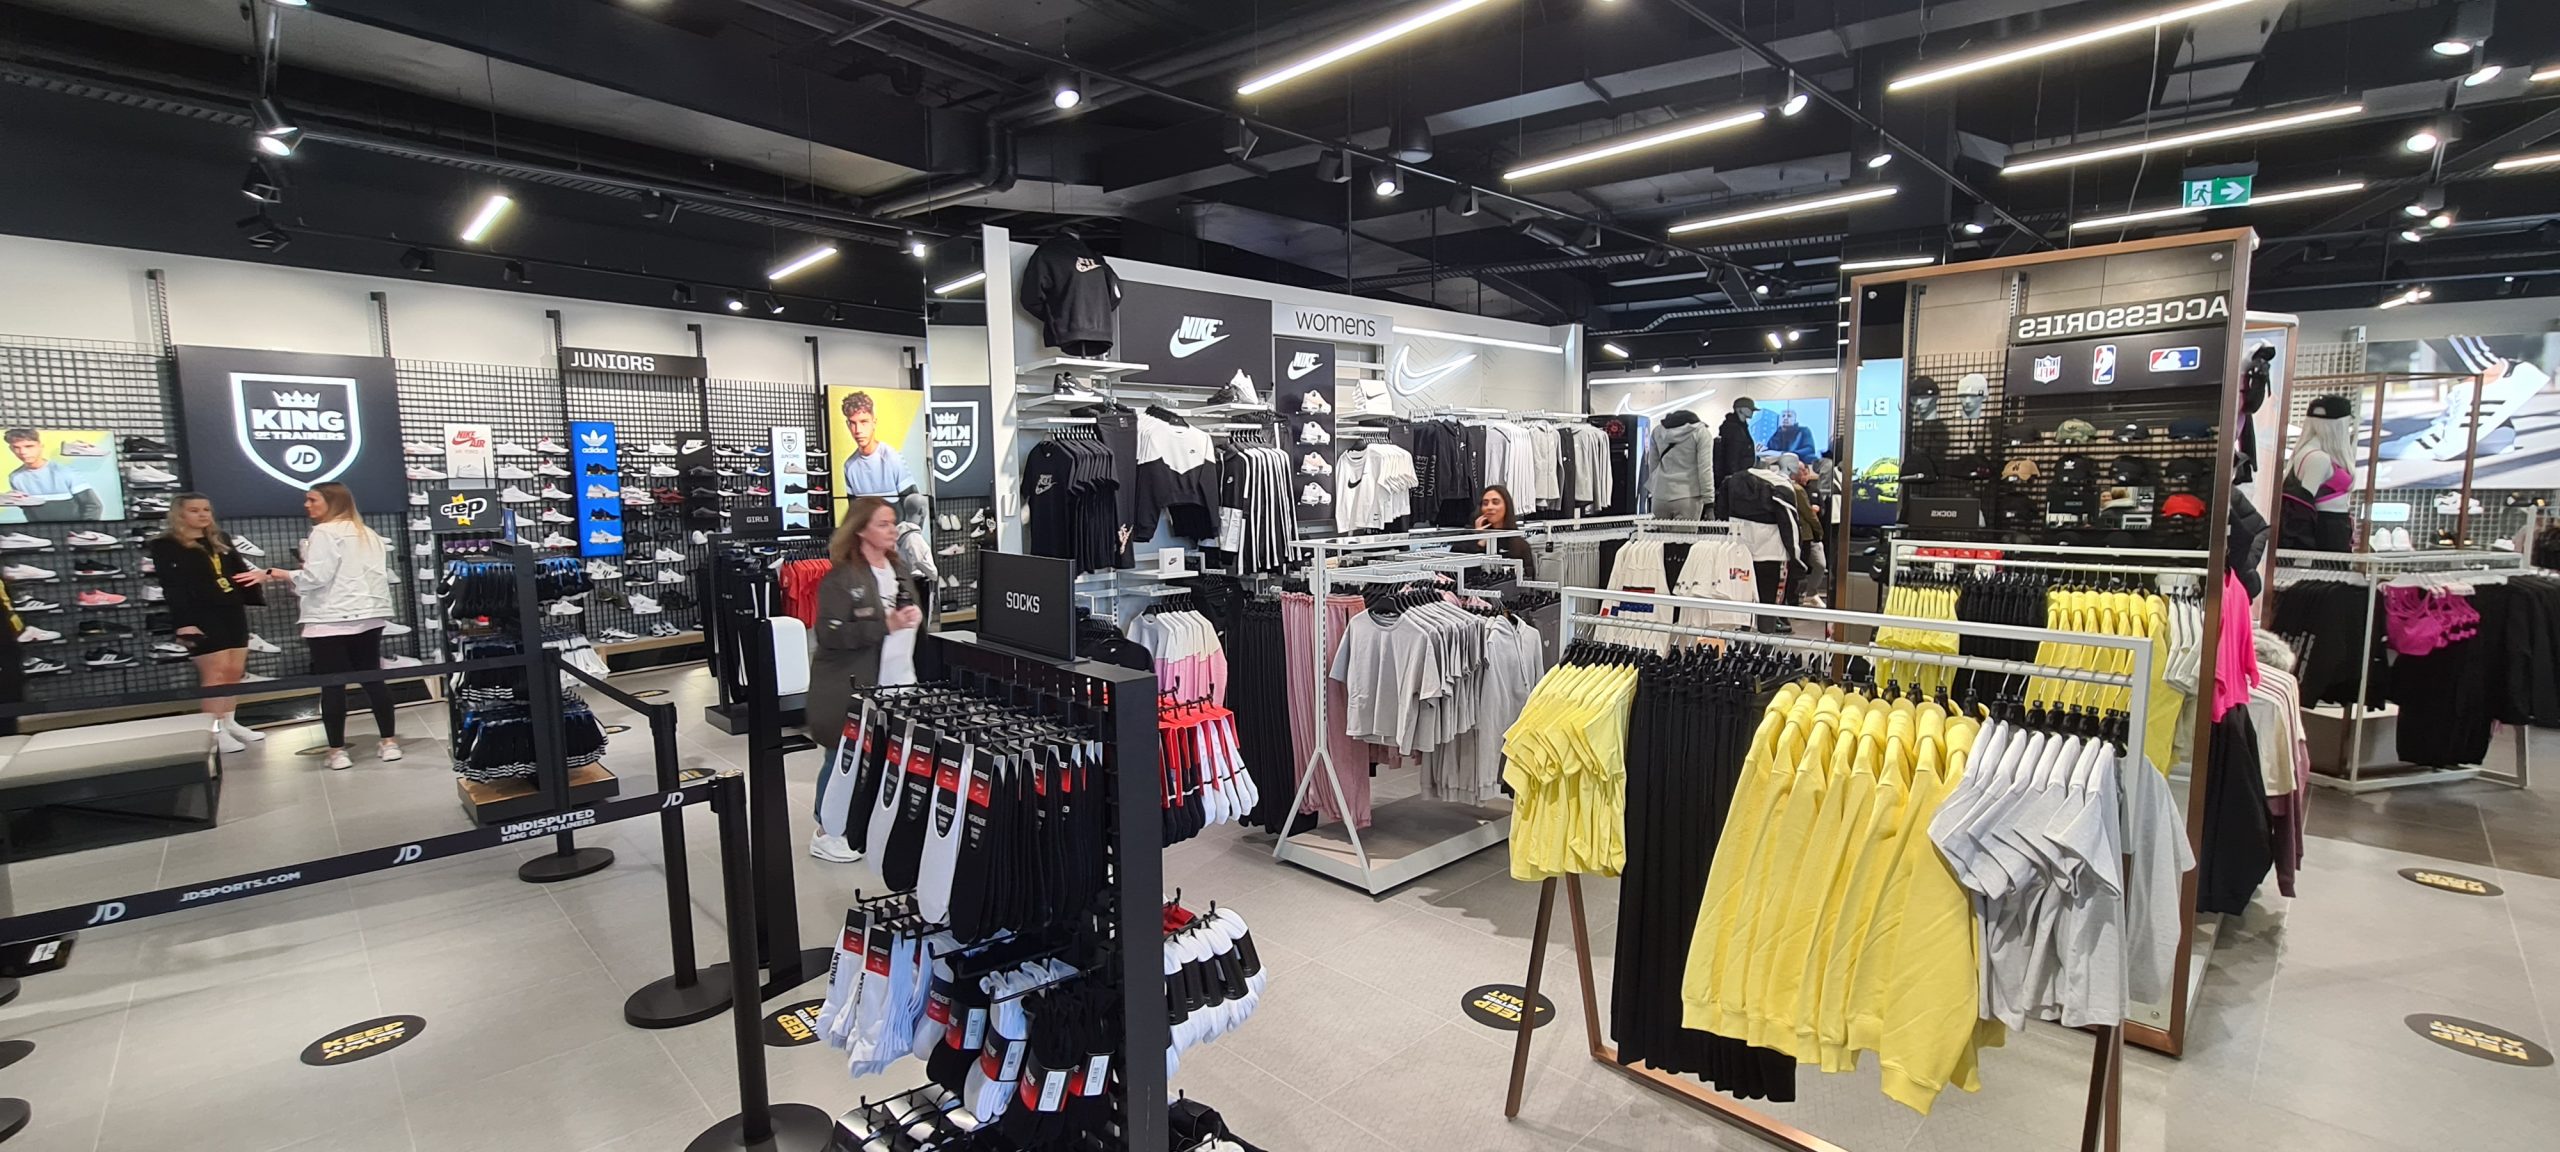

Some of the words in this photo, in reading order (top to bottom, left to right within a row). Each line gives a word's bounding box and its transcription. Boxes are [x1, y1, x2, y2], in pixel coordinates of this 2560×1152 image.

[1178, 315, 1219, 340] NIKE
[1295, 311, 1376, 337] womens
[570, 351, 655, 372] JUNIORS
[1293, 351, 1319, 368] NIKE
[251, 408, 345, 432] KING
[456, 431, 477, 439] NIKE
[469, 439, 486, 448] AIR
[292, 452, 318, 465] JD
[442, 499, 485, 519] crep
[746, 515, 769, 523] GIRLS
[1006, 591, 1040, 614] SOCKS
[662, 791, 685, 808] JD
[500, 809, 596, 835] UNDISPUTED
[501, 831, 527, 842] KING
[529, 828, 543, 837] OF
[546, 818, 596, 833] TRAINERS
[393, 844, 422, 865] JD
[179, 871, 301, 903] JDSPORTS.COM
[88, 902, 126, 925] JD
[322, 1021, 404, 1050] KEEP
[777, 1014, 813, 1041] KEEP
